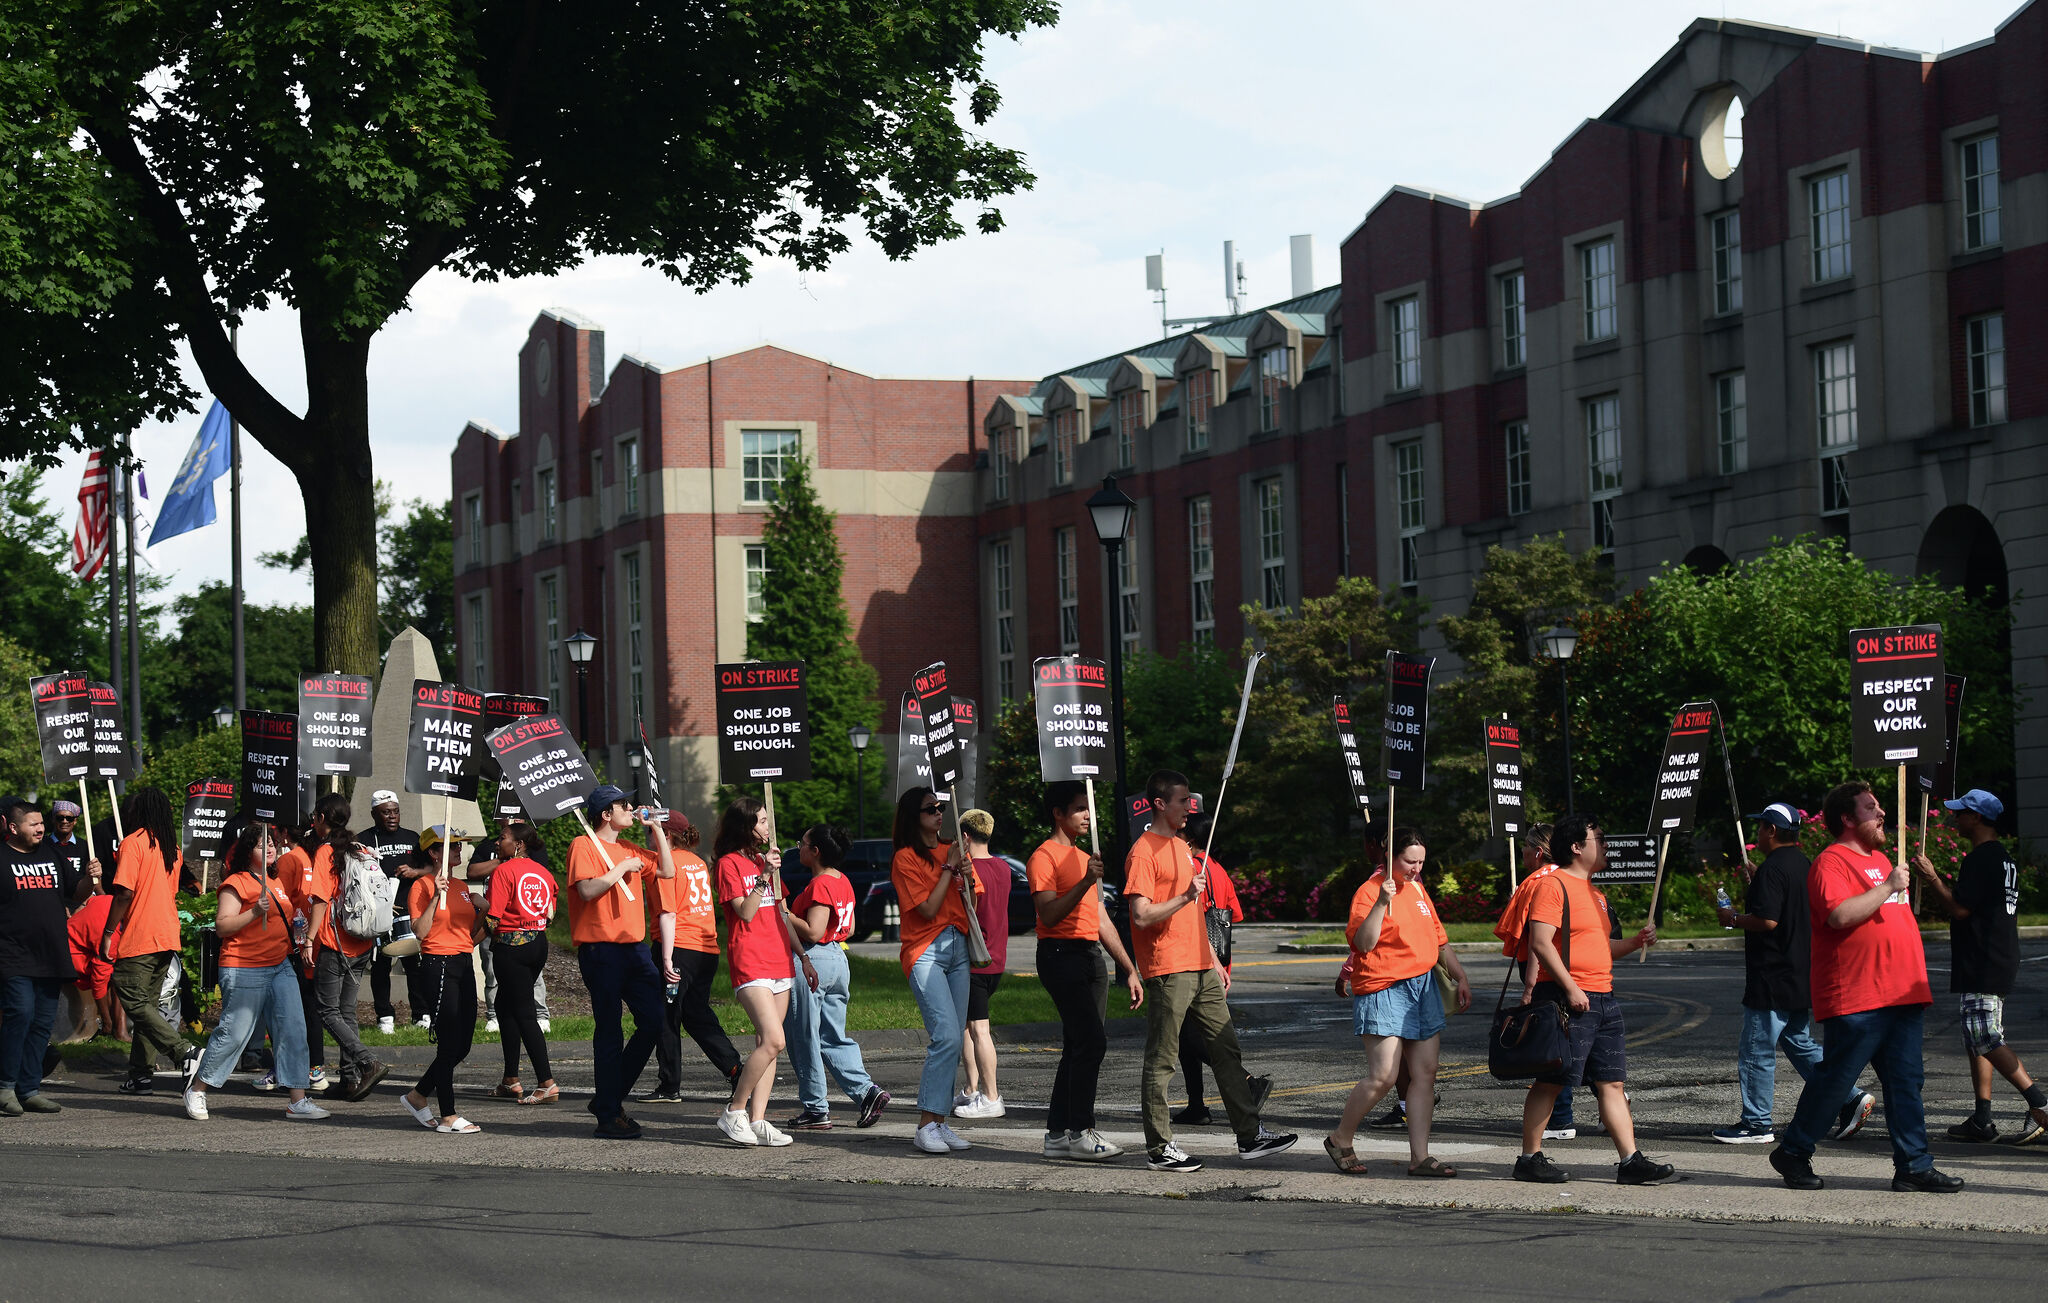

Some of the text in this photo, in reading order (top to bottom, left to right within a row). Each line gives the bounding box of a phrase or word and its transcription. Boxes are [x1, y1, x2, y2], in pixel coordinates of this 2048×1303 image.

[1856, 633, 1937, 655] ON STRIKE
[721, 668, 800, 685] ON STRIKE
[1040, 664, 1105, 681] ON STRIKE
[37, 678, 87, 696] ON STRIKE
[304, 679, 368, 694] ON STRIKE
[915, 676, 930, 693] ON
[1863, 677, 1934, 696] RESPECT
[418, 687, 482, 709] ON STRIKE
[486, 699, 544, 713] ON STRIKE
[952, 703, 973, 718] IKE
[1053, 703, 1102, 716] ONE JOB
[1395, 704, 1415, 717] JOB
[1883, 698, 1917, 713] OUR
[45, 712, 89, 728] RESPECT
[313, 711, 360, 723] ONE JOB
[733, 707, 792, 720] ONE JOB
[929, 711, 943, 726] ONE
[1684, 711, 1713, 728] STRIKE
[101, 719, 116, 728] JOB
[245, 716, 258, 729] ON
[424, 717, 473, 739] MAKE
[726, 722, 801, 736] SHOULD BE
[1046, 720, 1109, 732] SHOULD BE
[1406, 722, 1421, 735] BE
[1873, 715, 1927, 733] WORK.
[63, 727, 85, 740] OUR
[111, 732, 123, 741] BE
[306, 724, 367, 737] SHOULD BE
[494, 718, 561, 749] ON STRIKE
[1488, 725, 1519, 742] ON STRIKE
[57, 741, 91, 755] WORK.
[312, 738, 361, 750] ENOUGH.
[422, 736, 472, 757] THEM
[733, 738, 796, 751] ENOUGH.
[1054, 735, 1106, 748] ENOUGH.
[95, 744, 121, 754] OUGH.
[247, 751, 290, 767] RESPECT
[426, 755, 465, 776] PAY.
[519, 749, 568, 771] ONE JOB
[1668, 752, 1700, 767] ONE JOB
[256, 768, 275, 781] OUR
[518, 762, 565, 787] SHOULD
[564, 758, 582, 770] BE
[1496, 762, 1519, 775] ONE JOB
[1661, 768, 1701, 784] SHOULD BE
[189, 782, 234, 795] ON STRIKE
[251, 782, 283, 797] WORK.
[530, 772, 584, 796] ENOUGH.
[1493, 778, 1522, 791] SHOULD BE
[1497, 793, 1521, 806] ENOUGH.
[1660, 786, 1692, 801] ENOUGH.
[194, 807, 226, 818] ONE JOB
[188, 818, 217, 828] SHOULD
[192, 829, 223, 839] ENOUGH
[1607, 840, 1640, 848] STRATION
[10, 862, 58, 877] UNITE
[1610, 861, 1656, 869] SELF PARKING
[1627, 870, 1656, 878] PARKING
[1864, 868, 1884, 880] WE
[15, 875, 59, 890] HERE!
[523, 881, 543, 890] Local
[686, 870, 712, 905] 33
[524, 890, 544, 908] 34
